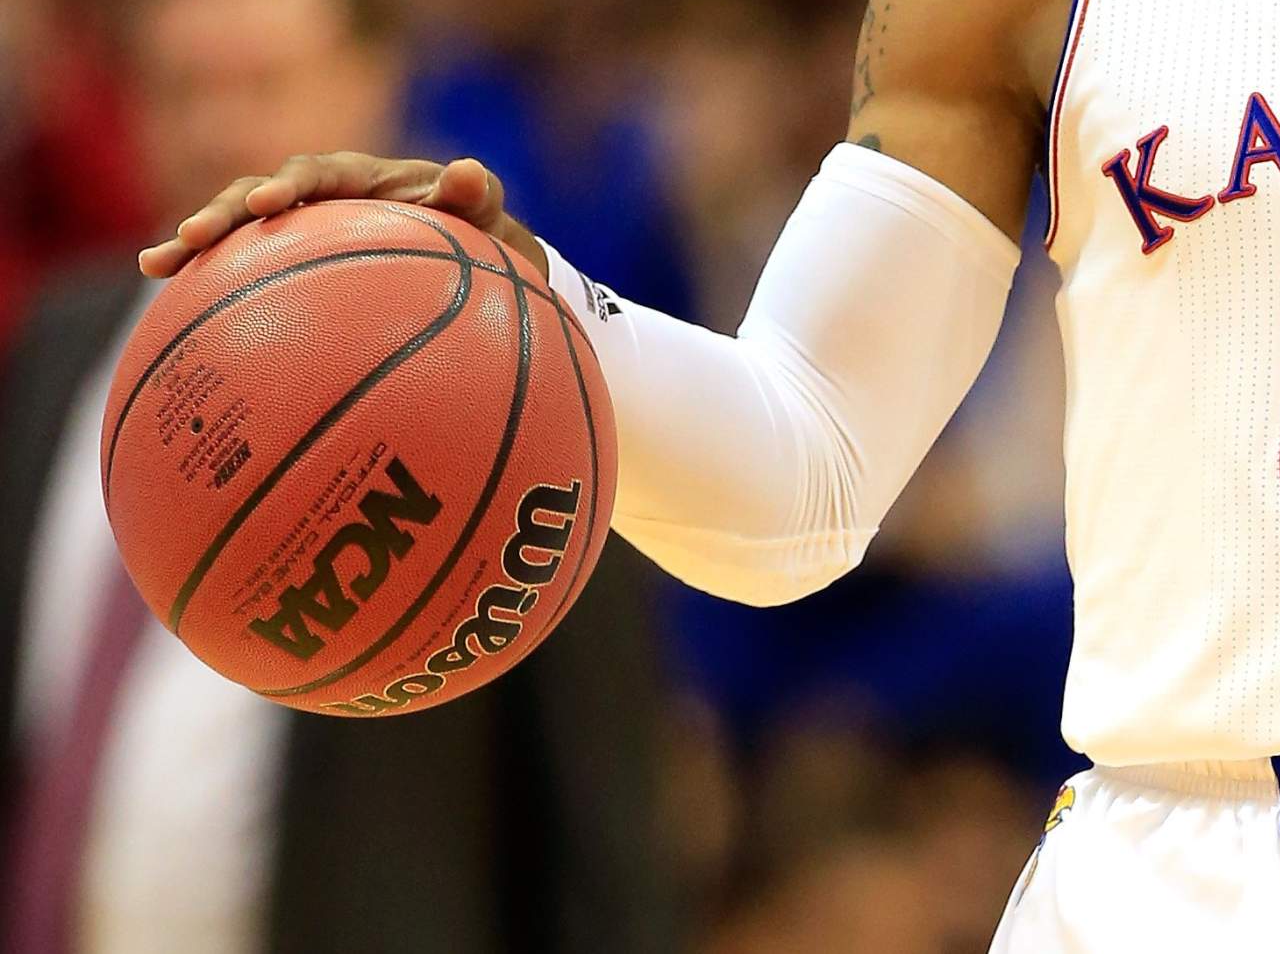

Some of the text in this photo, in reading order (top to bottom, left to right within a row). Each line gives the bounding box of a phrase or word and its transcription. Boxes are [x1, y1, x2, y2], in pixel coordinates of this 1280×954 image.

[248, 457, 443, 661] NCAA
[321, 442, 386, 523] OFFICIAL
[320, 479, 581, 715] Wilson
